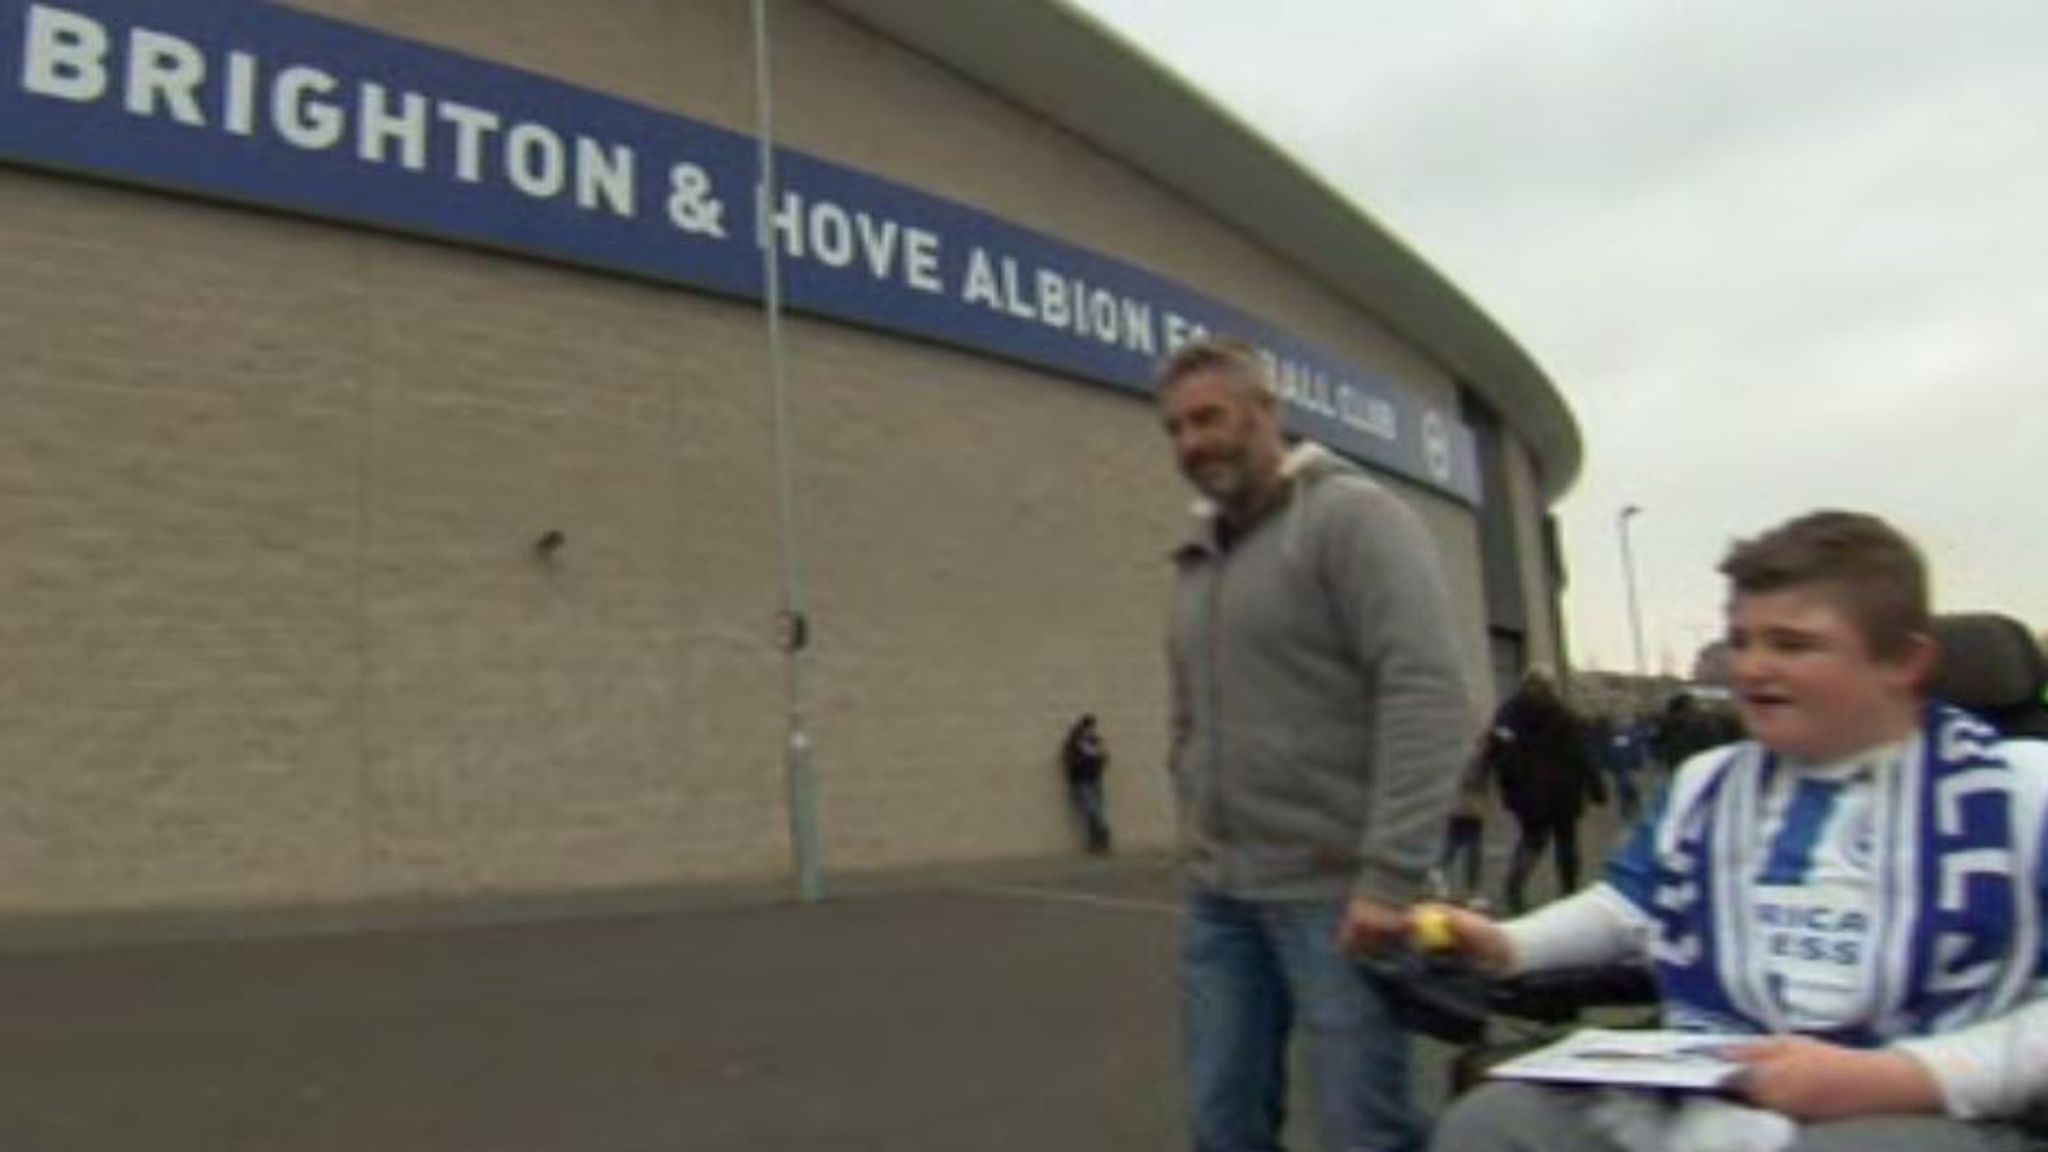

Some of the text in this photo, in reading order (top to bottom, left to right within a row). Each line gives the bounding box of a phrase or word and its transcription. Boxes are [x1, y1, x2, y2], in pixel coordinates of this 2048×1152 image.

[22, 2, 638, 218] BRIGHTON
[665, 162, 728, 239] &
[755, 181, 944, 293] HOVE
[962, 248, 1156, 355] ALBION
